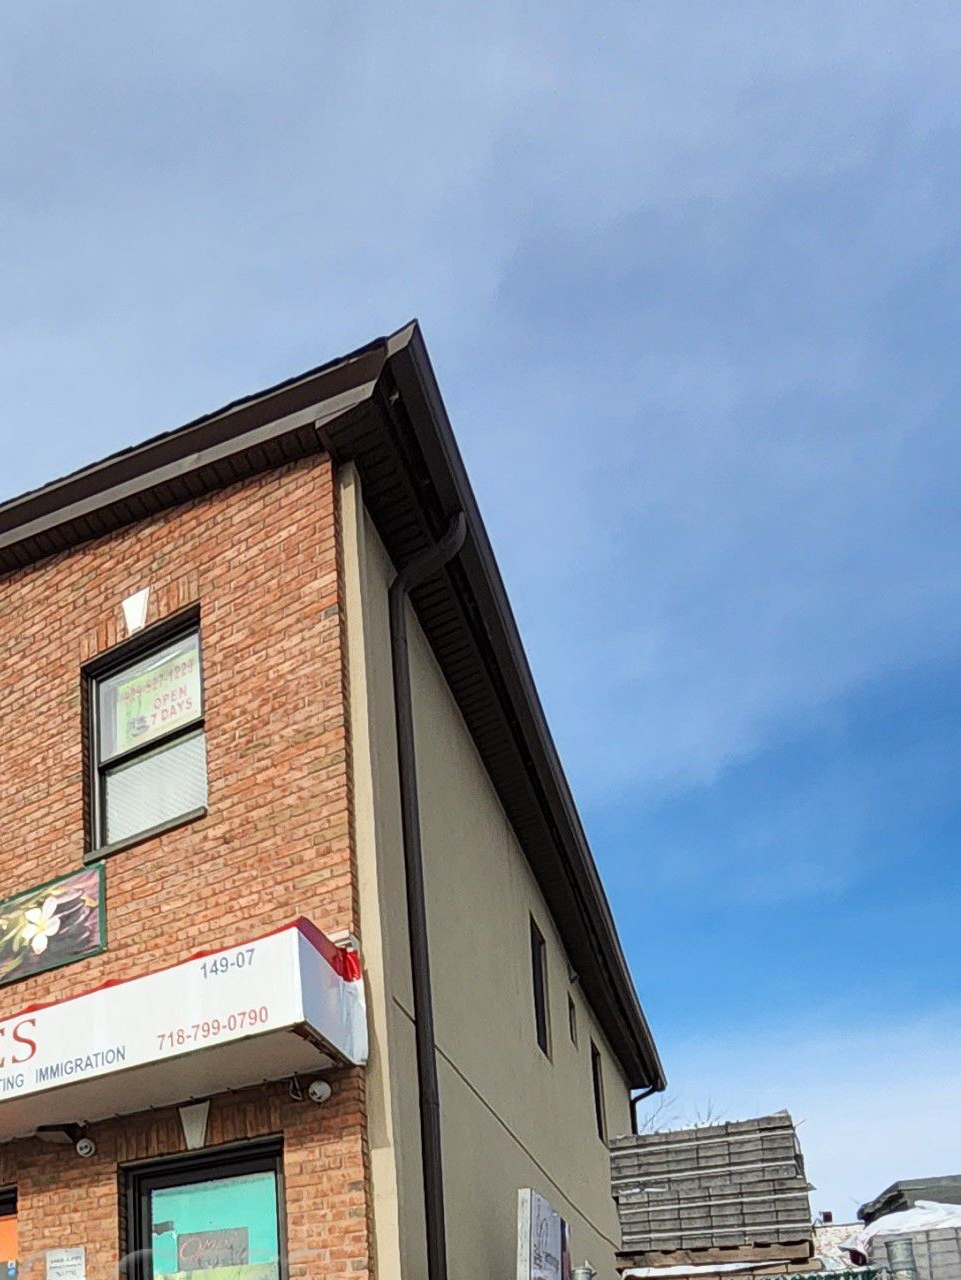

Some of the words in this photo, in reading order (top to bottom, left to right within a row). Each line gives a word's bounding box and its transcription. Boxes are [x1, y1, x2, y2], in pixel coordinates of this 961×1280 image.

[150, 713, 158, 726] 7
[161, 697, 193, 721] DAYS
[153, 684, 187, 710] OPEN
[200, 948, 255, 979] 149-07
[157, 1006, 269, 1051] 718-799-0790
[35, 1045, 126, 1084] IMMIGRATION
